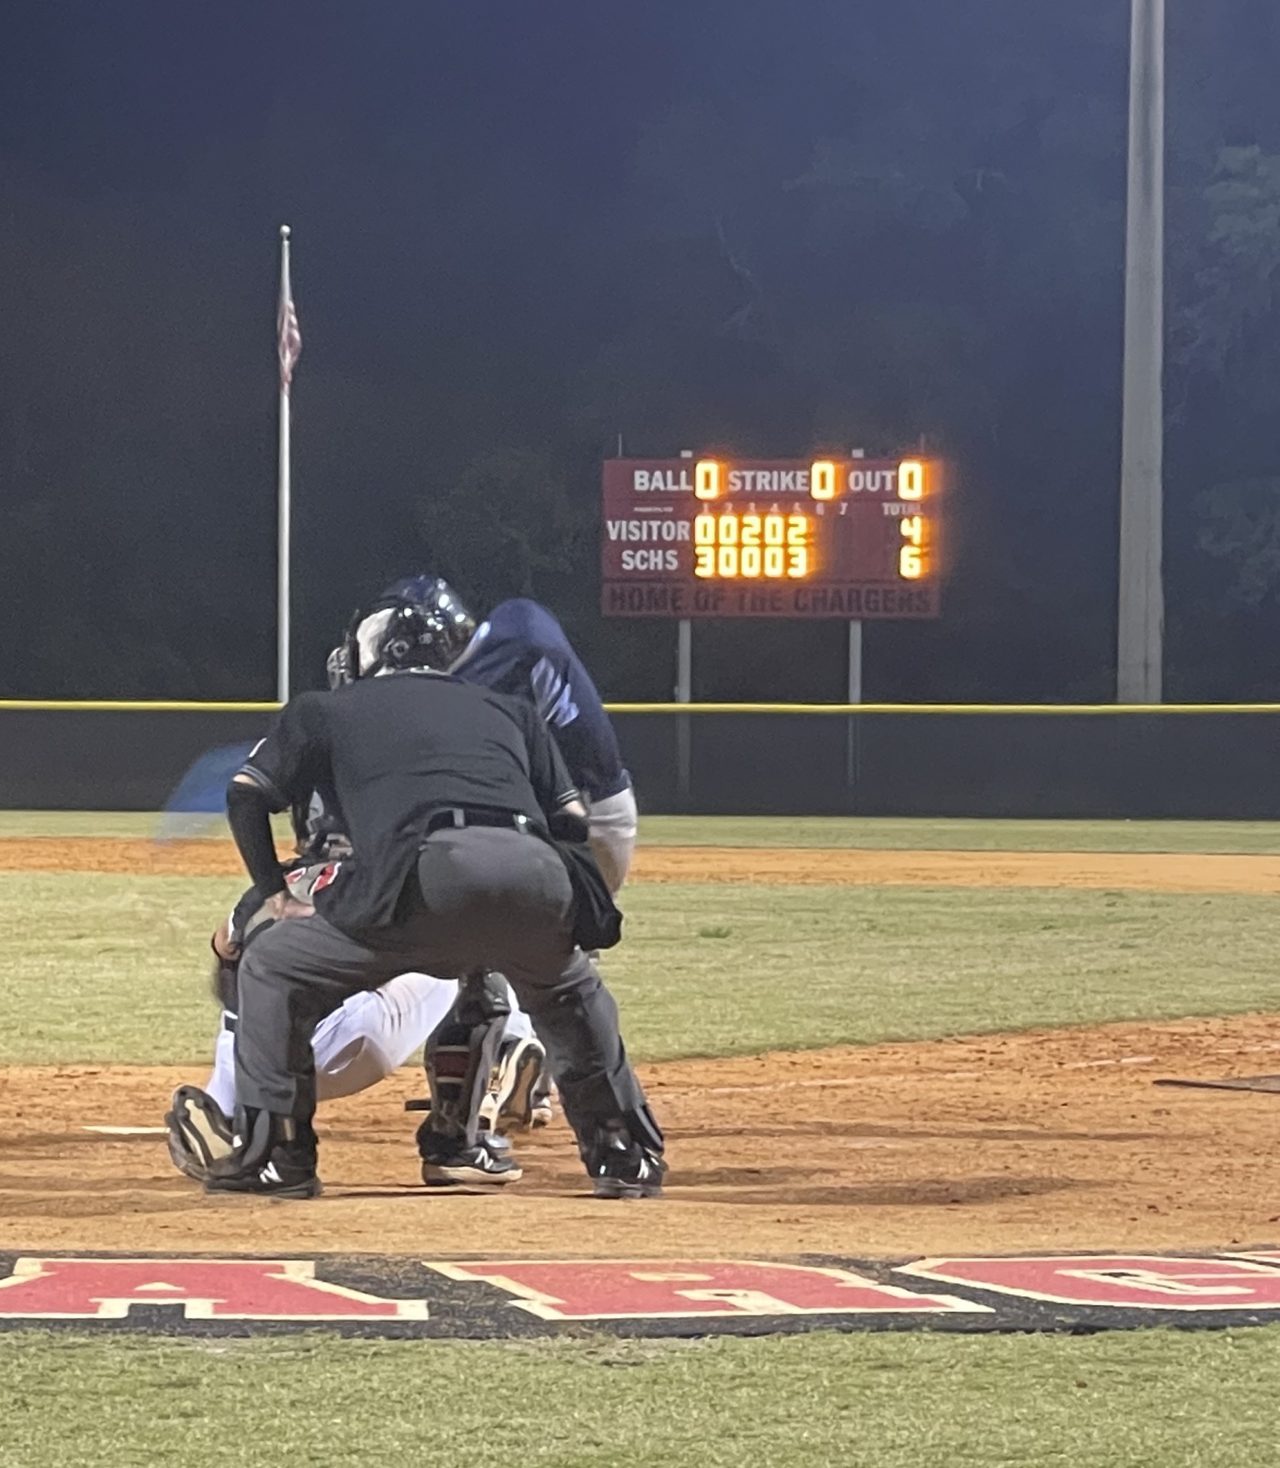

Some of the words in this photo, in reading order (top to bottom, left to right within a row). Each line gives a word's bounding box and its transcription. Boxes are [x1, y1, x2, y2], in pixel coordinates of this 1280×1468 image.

[634, 470, 694, 491] BALL
[695, 461, 720, 500] 0
[728, 470, 809, 491] STRIKE
[811, 461, 836, 500] 0
[848, 470, 896, 492] OUT
[898, 461, 923, 500] 0
[607, 520, 690, 541] VISITOR
[900, 515, 922, 545] 4
[622, 549, 678, 570] SCHS
[900, 545, 922, 578] 6
[609, 587, 684, 612] HOME
[694, 587, 727, 612] OF
[737, 587, 782, 612] THE
[794, 586, 931, 613] CHARGERS
